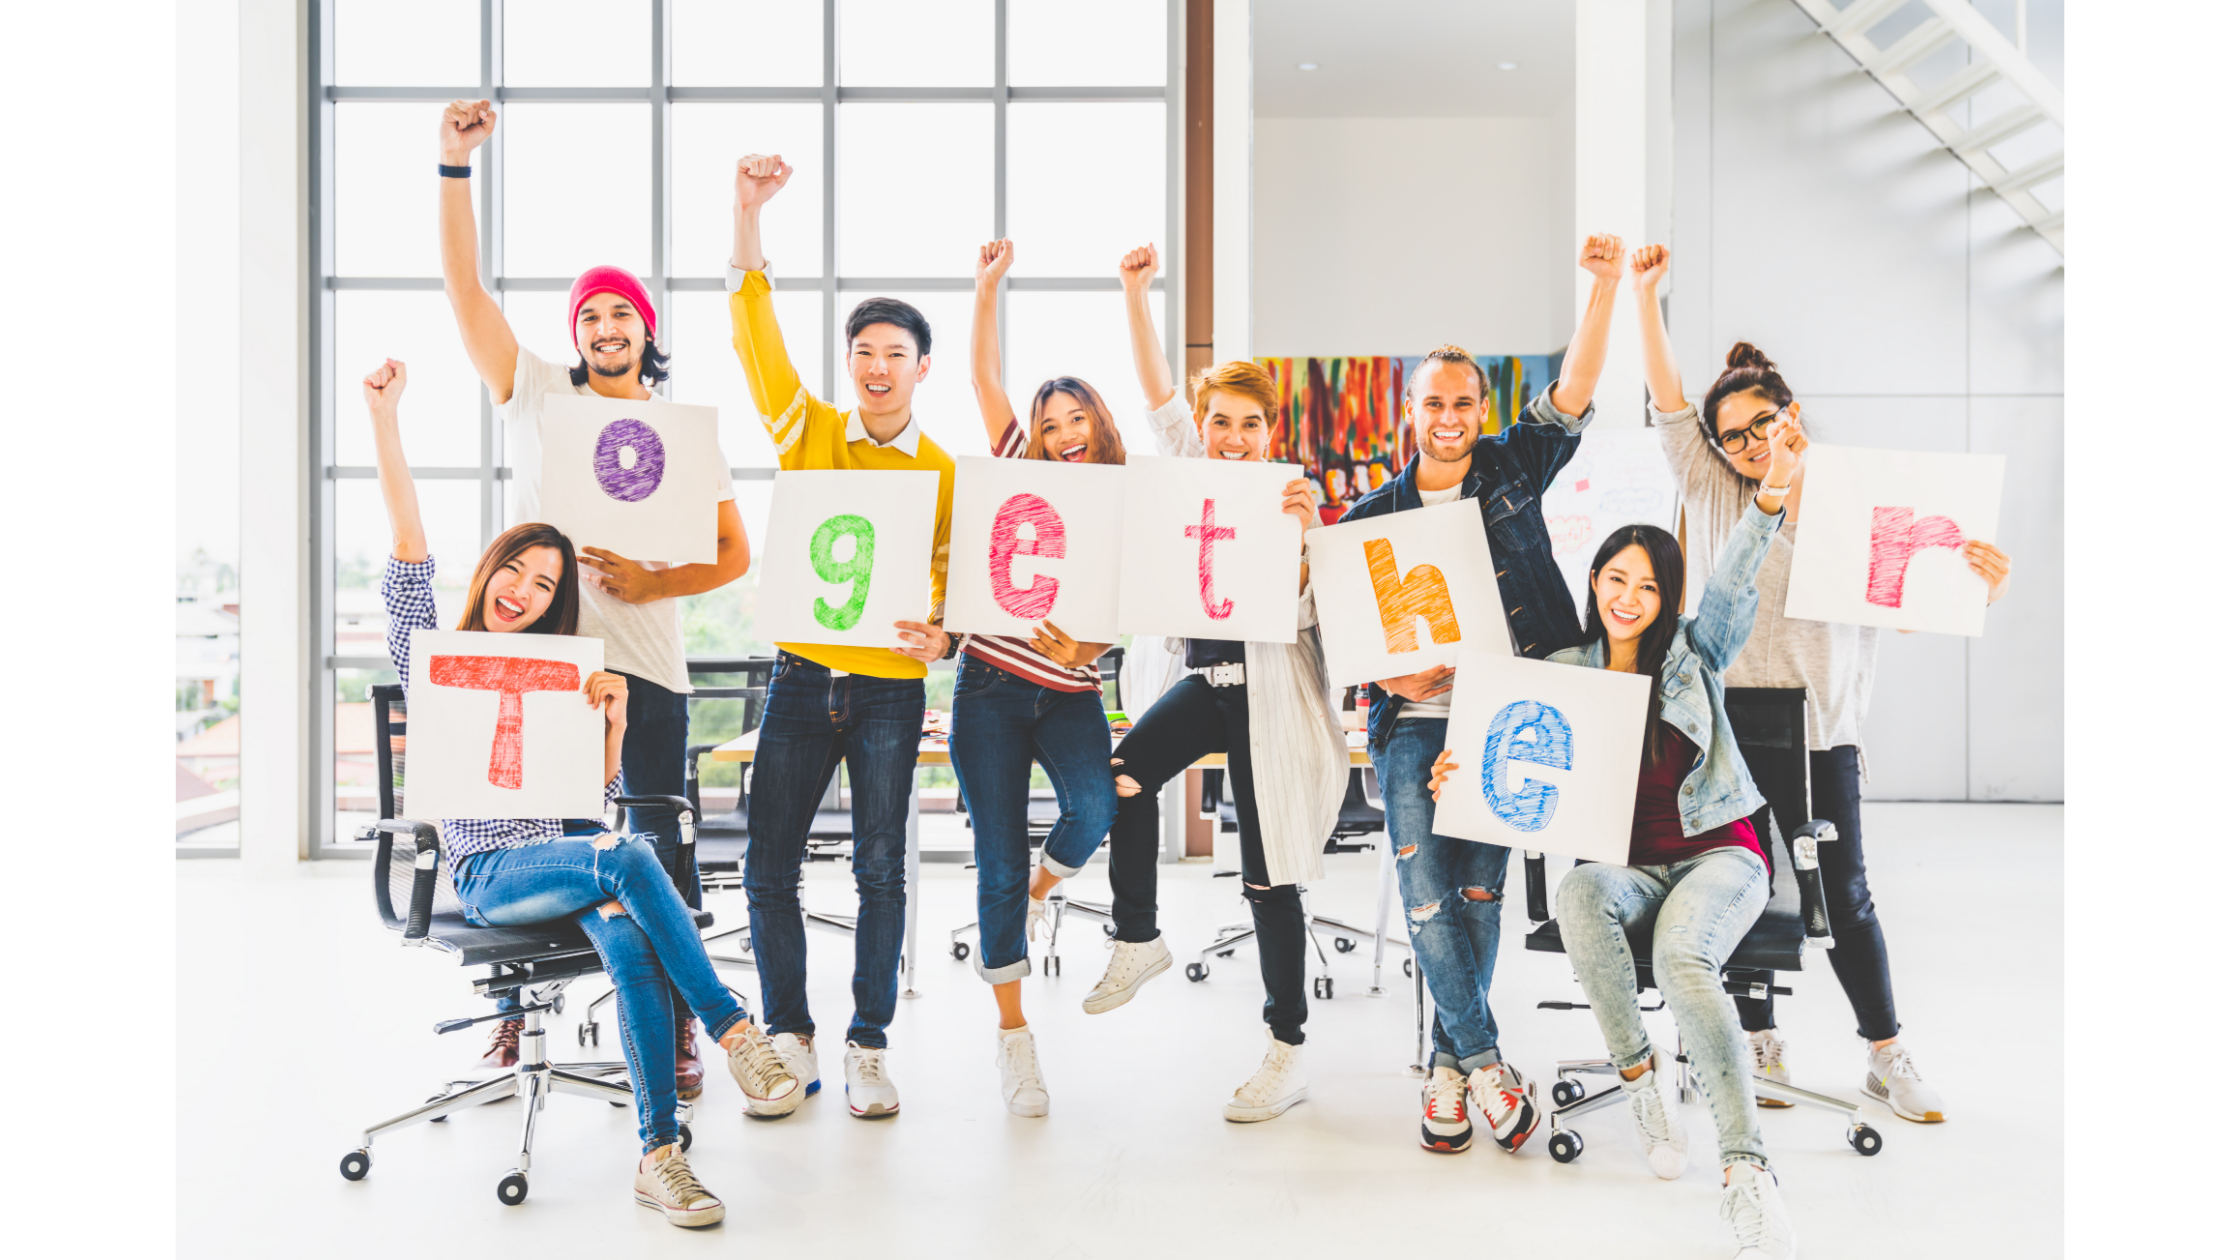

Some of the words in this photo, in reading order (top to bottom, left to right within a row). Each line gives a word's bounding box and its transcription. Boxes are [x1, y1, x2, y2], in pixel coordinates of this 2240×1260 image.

[810, 514, 875, 631] g
[989, 493, 1066, 619] e
[1186, 499, 1236, 620] t
[1364, 539, 1461, 654] h
[1866, 506, 1966, 608] r
[429, 655, 579, 789] T
[1481, 700, 1573, 831] e
